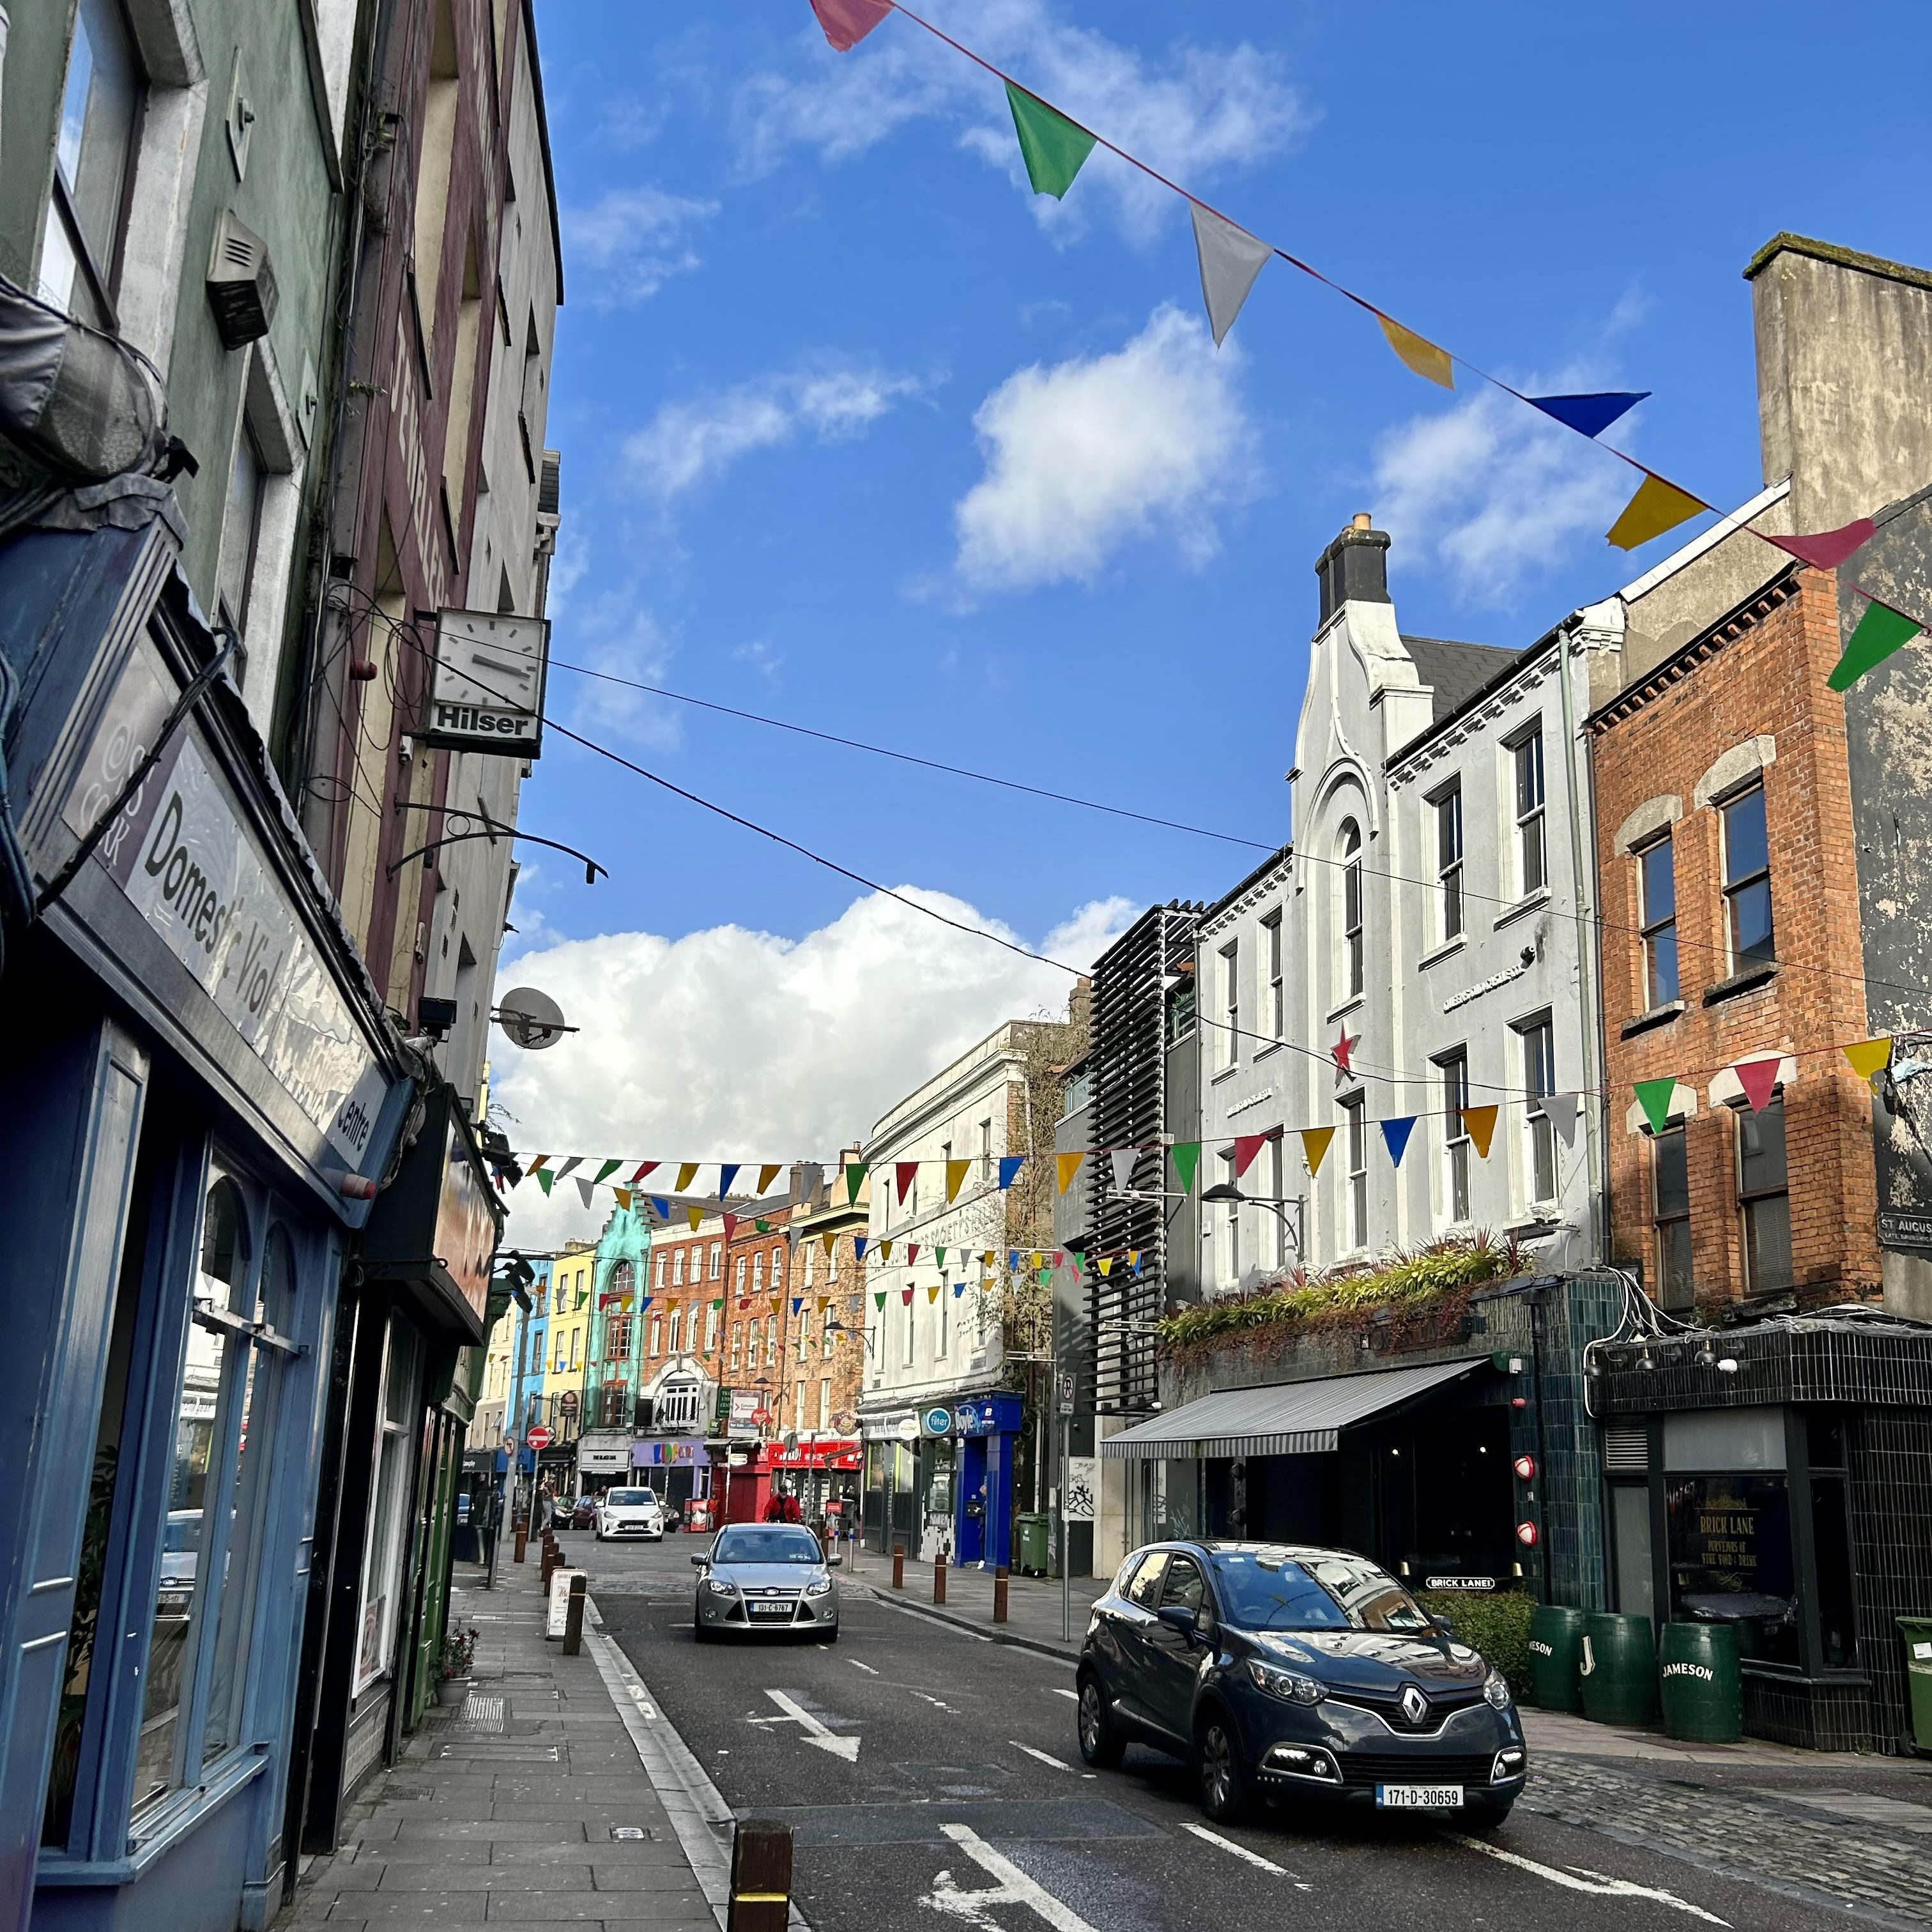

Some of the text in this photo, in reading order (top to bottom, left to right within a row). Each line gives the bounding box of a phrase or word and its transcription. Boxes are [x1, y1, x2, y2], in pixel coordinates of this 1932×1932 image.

[389, 310, 450, 613] JEWELLER
[437, 705, 529, 735] Hilser
[1881, 1218, 1894, 1230] ST
[930, 1414, 949, 1426] filter
[1699, 1515, 1755, 1535] BRICK LANE
[1431, 1579, 1459, 1587] BRICK
[1579, 1635, 1595, 1676] J
[1662, 1662, 1713, 1682] JAMESON
[1388, 1790, 1458, 1805] 171-D-30659
